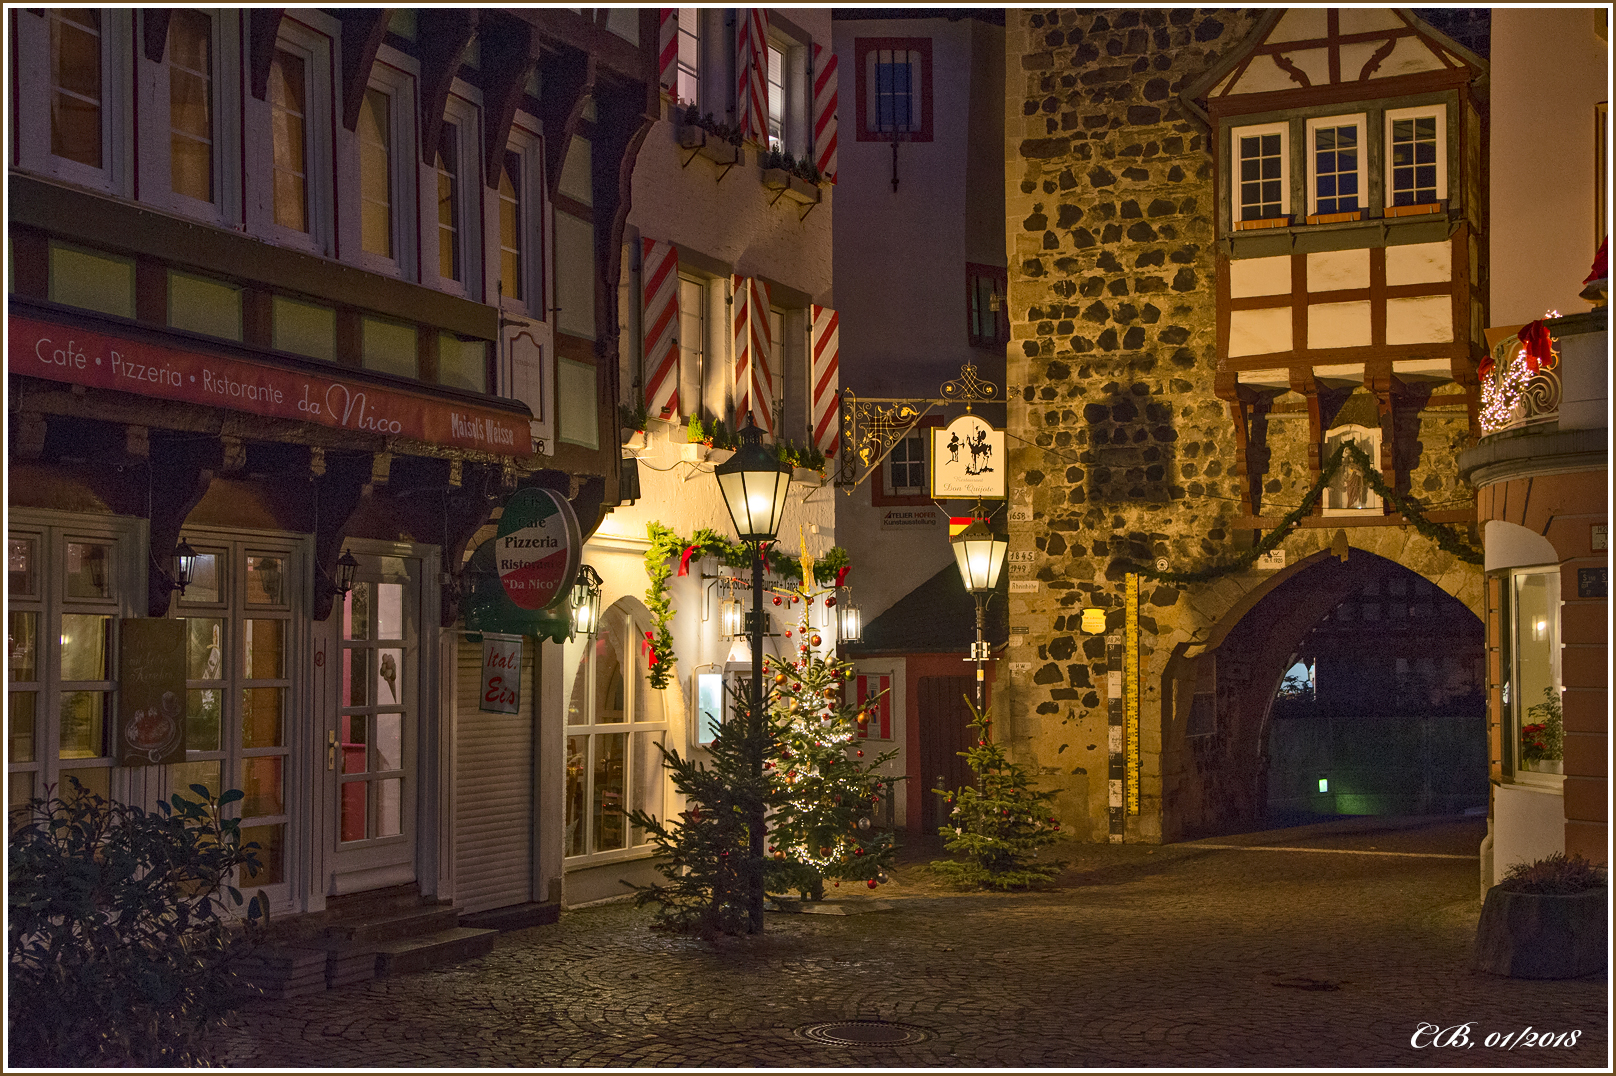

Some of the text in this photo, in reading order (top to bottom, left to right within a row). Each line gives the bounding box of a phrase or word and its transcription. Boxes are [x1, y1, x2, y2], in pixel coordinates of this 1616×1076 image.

[35, 338, 402, 434] Café Pizzeria Ristorante da Nico
[485, 418, 514, 446] Weisse
[943, 482, 961, 492] Don
[884, 510, 912, 519] ATELIER
[504, 535, 558, 549] Pizzeria
[501, 559, 562, 571] Ristorante
[504, 579, 559, 589] "Da Nico"
[487, 646, 517, 670] Ital.
[485, 676, 515, 705] Eis
